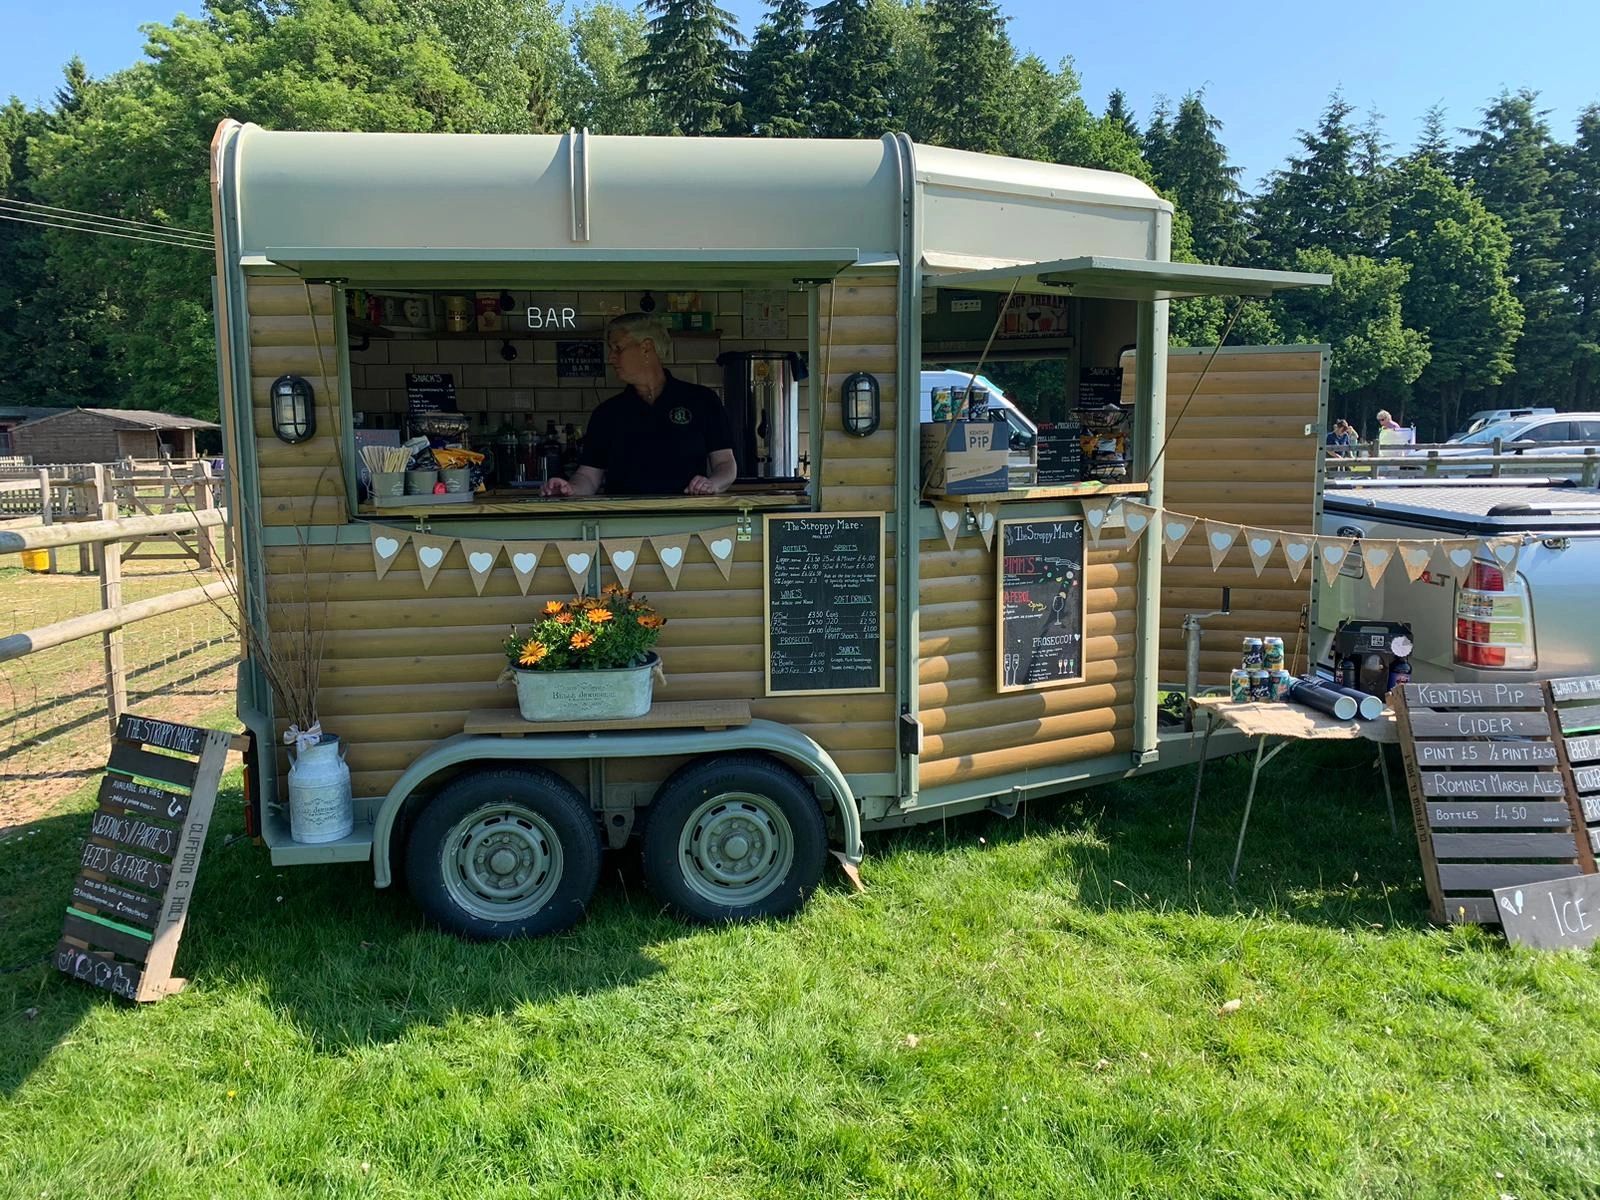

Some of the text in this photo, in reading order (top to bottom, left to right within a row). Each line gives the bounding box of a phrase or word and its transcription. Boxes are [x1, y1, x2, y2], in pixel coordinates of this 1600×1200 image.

[527, 306, 577, 329] BAR
[800, 519, 835, 535] Stroppy
[837, 519, 860, 530] Mare
[1026, 524, 1054, 544] Stroppy
[1053, 523, 1073, 540] Mare
[834, 595, 849, 604] SOFT
[1032, 634, 1073, 648] PROSECCO!
[1417, 683, 1525, 705] KENTISH PIP
[125, 717, 143, 739] THE
[172, 726, 199, 753] MARE
[1457, 714, 1515, 735] CIDER
[1423, 746, 1455, 760] PINT
[1461, 745, 1478, 760] £5
[1502, 746, 1530, 761] PINT
[1433, 774, 1563, 795] ROMNEY MARSH ALES
[1436, 808, 1480, 821] BOTTLES
[110, 852, 123, 875] &
[167, 823, 205, 925] CLIFFORD G. HOLT
[1548, 891, 1593, 937] ICE
